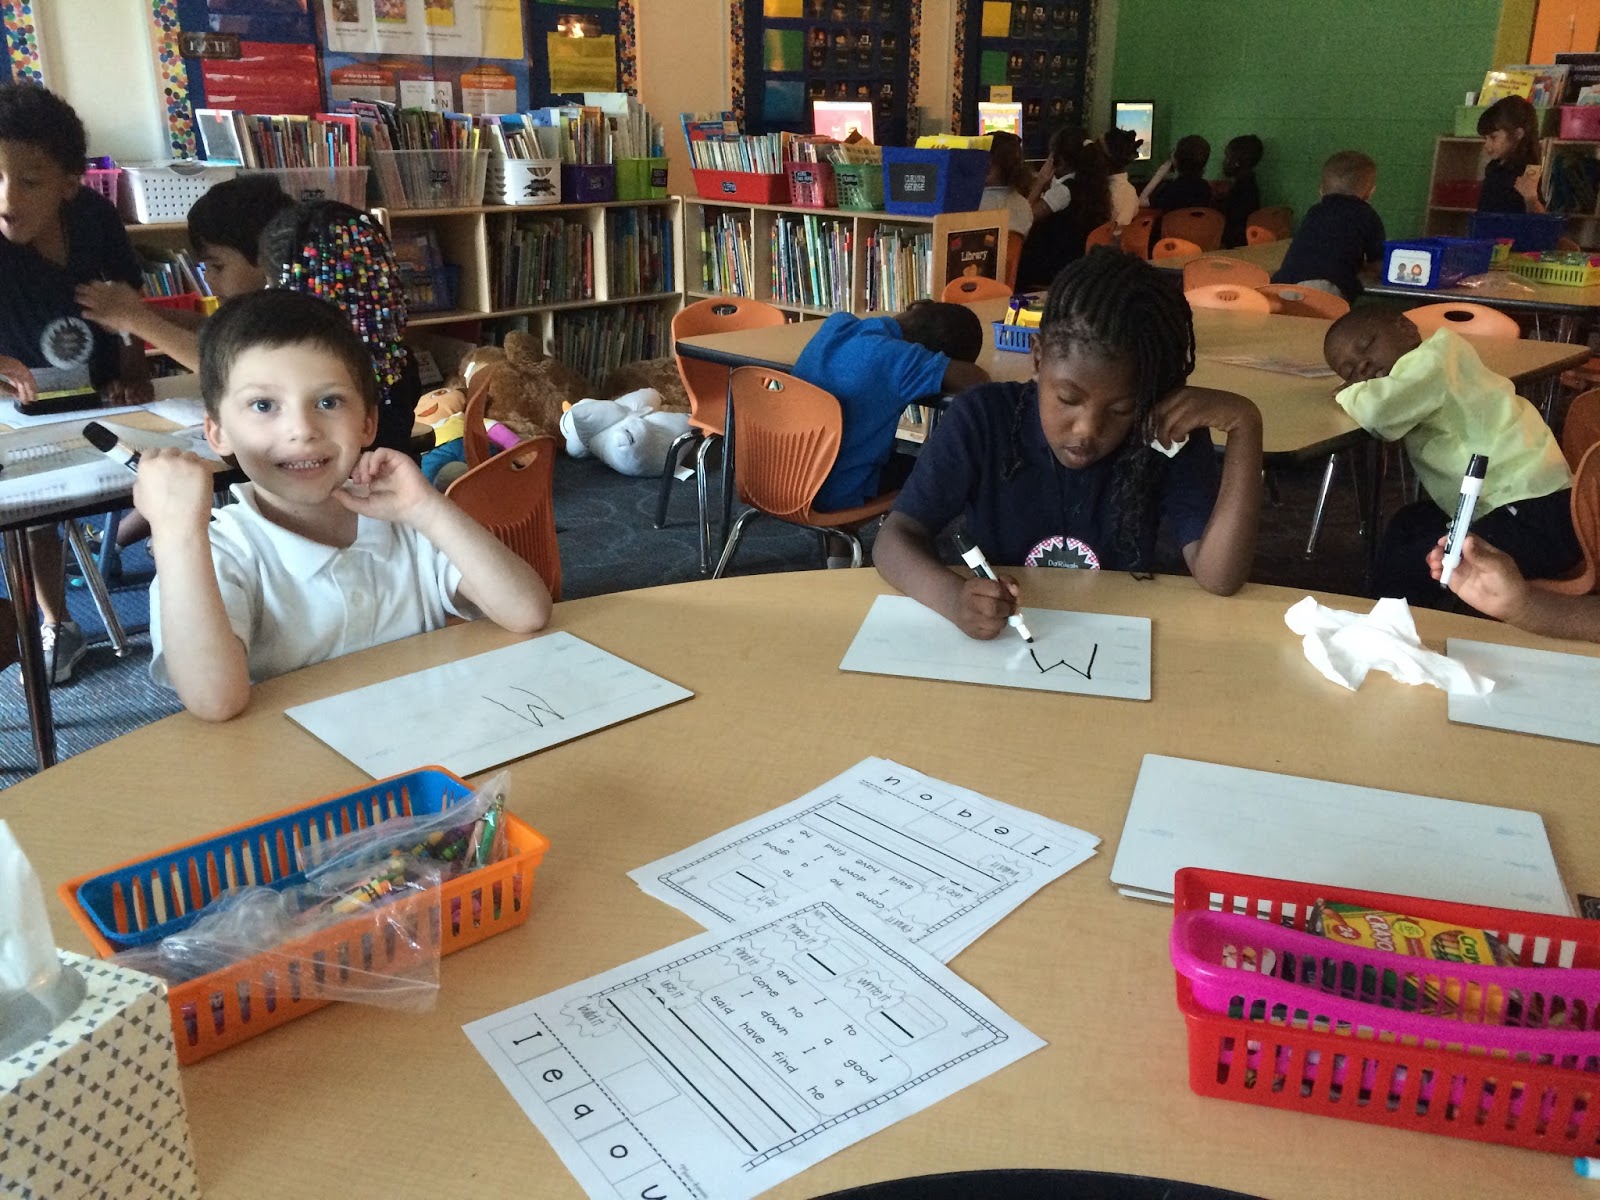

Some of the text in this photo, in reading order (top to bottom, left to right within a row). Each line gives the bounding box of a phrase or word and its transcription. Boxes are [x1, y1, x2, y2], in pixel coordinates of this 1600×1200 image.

[960, 250, 989, 262] Library
[762, 842, 790, 856] good
[799, 829, 914, 890] said have find he
[782, 869, 795, 878] to
[829, 877, 845, 887] no
[838, 865, 866, 882] down
[855, 890, 885, 909] come
[1364, 914, 1395, 952] CRAYO
[1459, 935, 1481, 964] Cray
[776, 969, 798, 986] and
[843, 1024, 857, 1037] to
[752, 975, 779, 998] come
[787, 1006, 804, 1019] no
[843, 1059, 879, 1084] good
[761, 1009, 789, 1037] down
[711, 995, 825, 1100] said have find he
[542, 1068, 563, 1083] e
[610, 1144, 628, 1159] o
